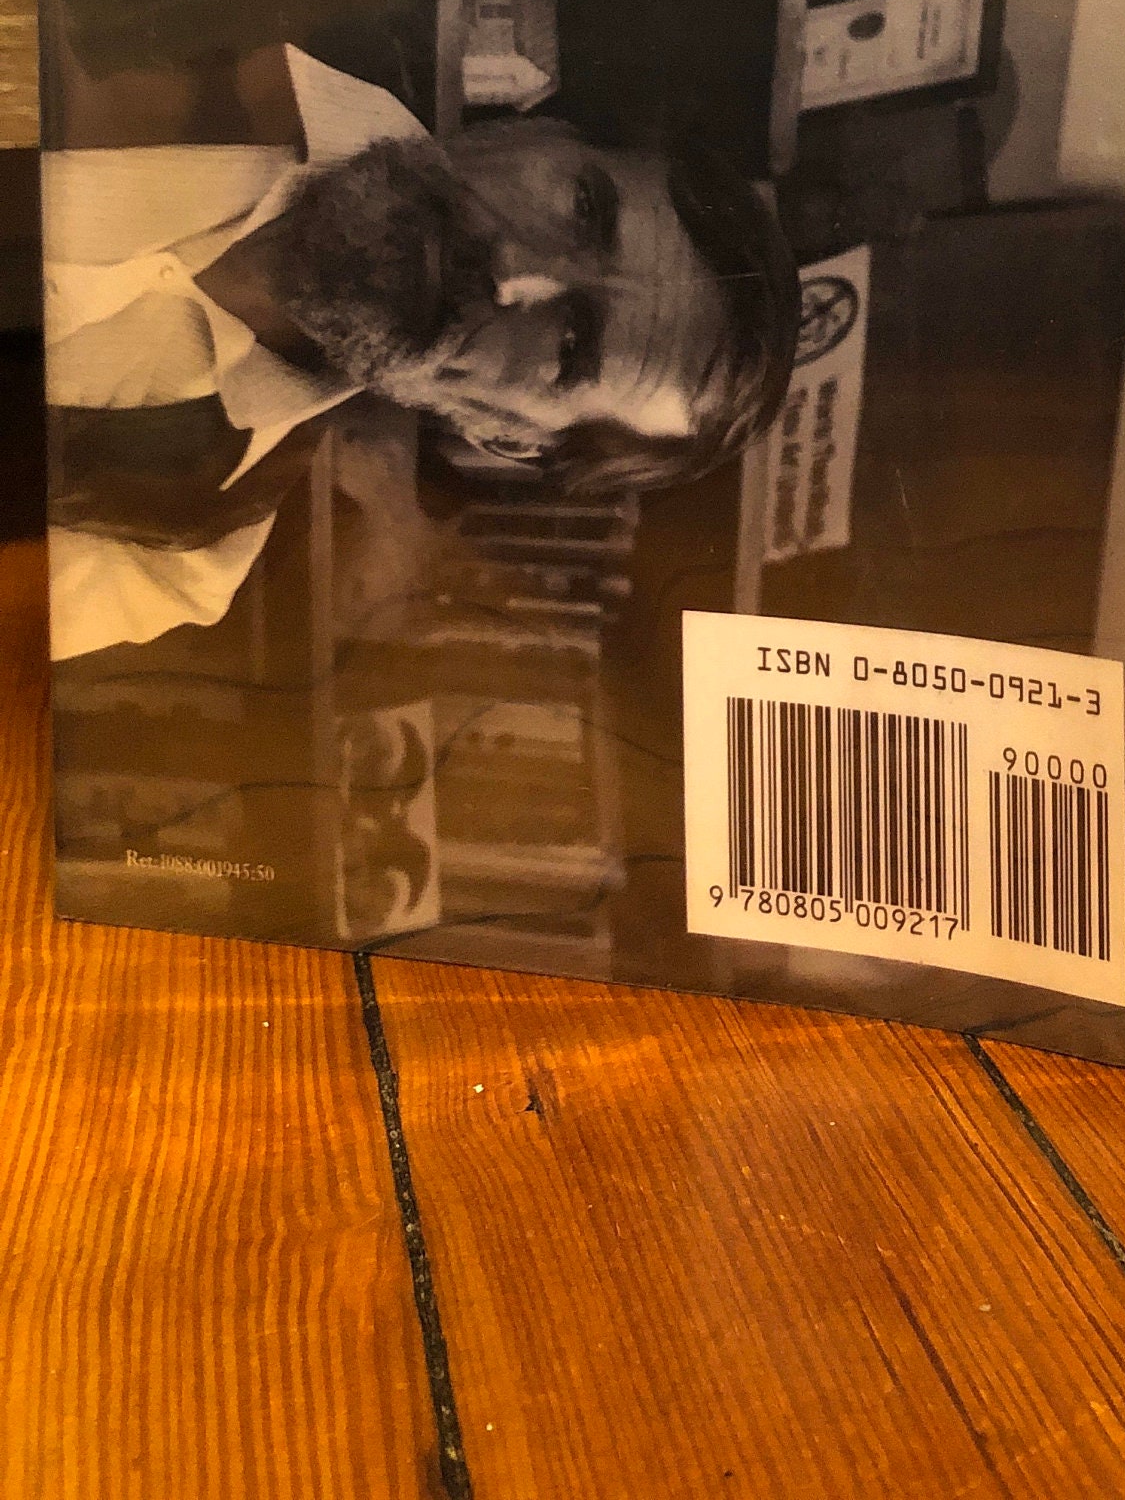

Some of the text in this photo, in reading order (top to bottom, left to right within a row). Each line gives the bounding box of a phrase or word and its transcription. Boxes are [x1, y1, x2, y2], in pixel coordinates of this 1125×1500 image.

[756, 646, 1102, 716] ISBN 0-8050-0921-3
[1002, 746, 1108, 789] 90000
[708, 884, 959, 941] 9 780805 009217
